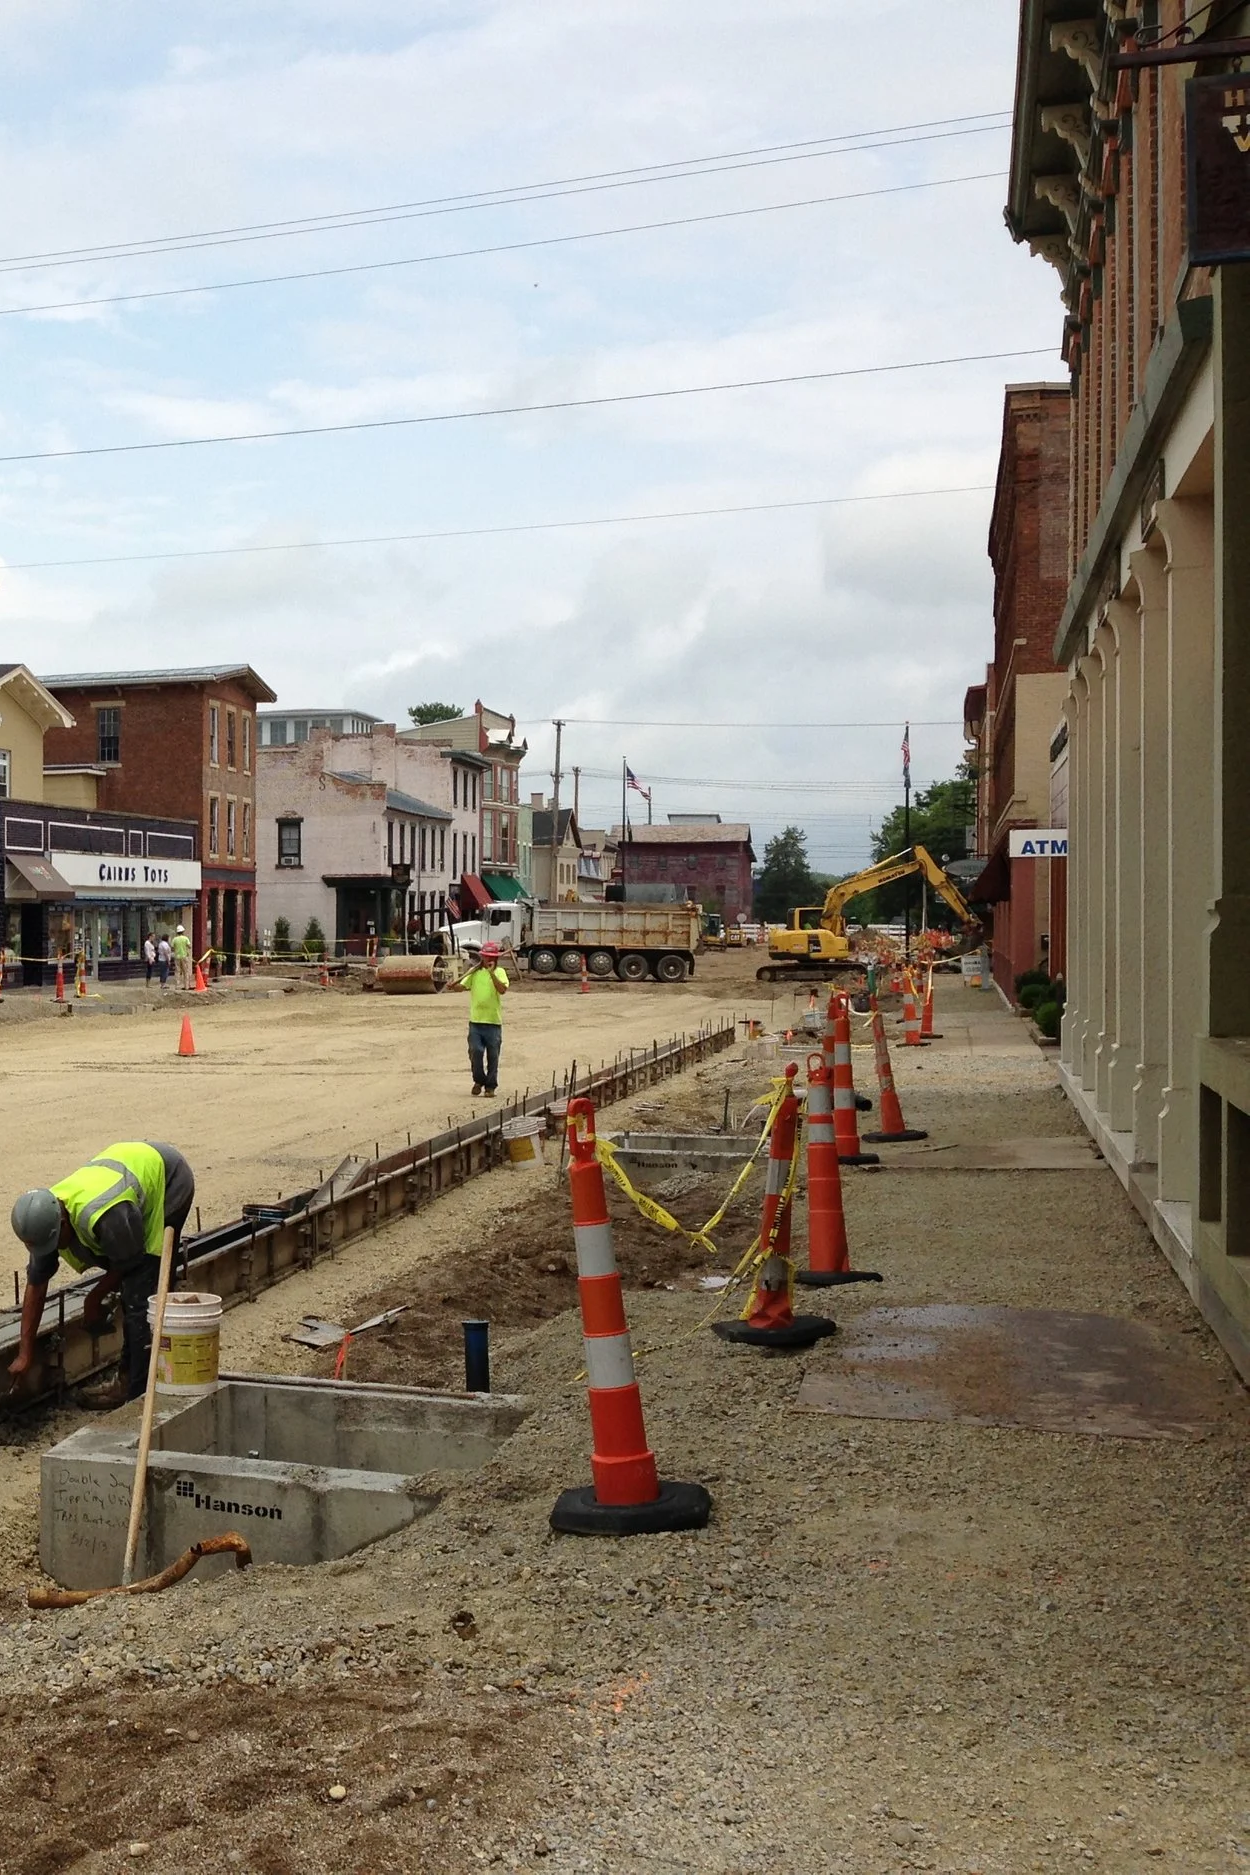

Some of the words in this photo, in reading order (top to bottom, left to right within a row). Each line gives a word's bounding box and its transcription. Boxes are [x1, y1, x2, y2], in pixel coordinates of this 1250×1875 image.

[1021, 840, 1067, 854] ATM
[730, 933, 741, 941] CAT
[58, 1468, 102, 1488] Double
[195, 1493, 282, 1520] Hanson
